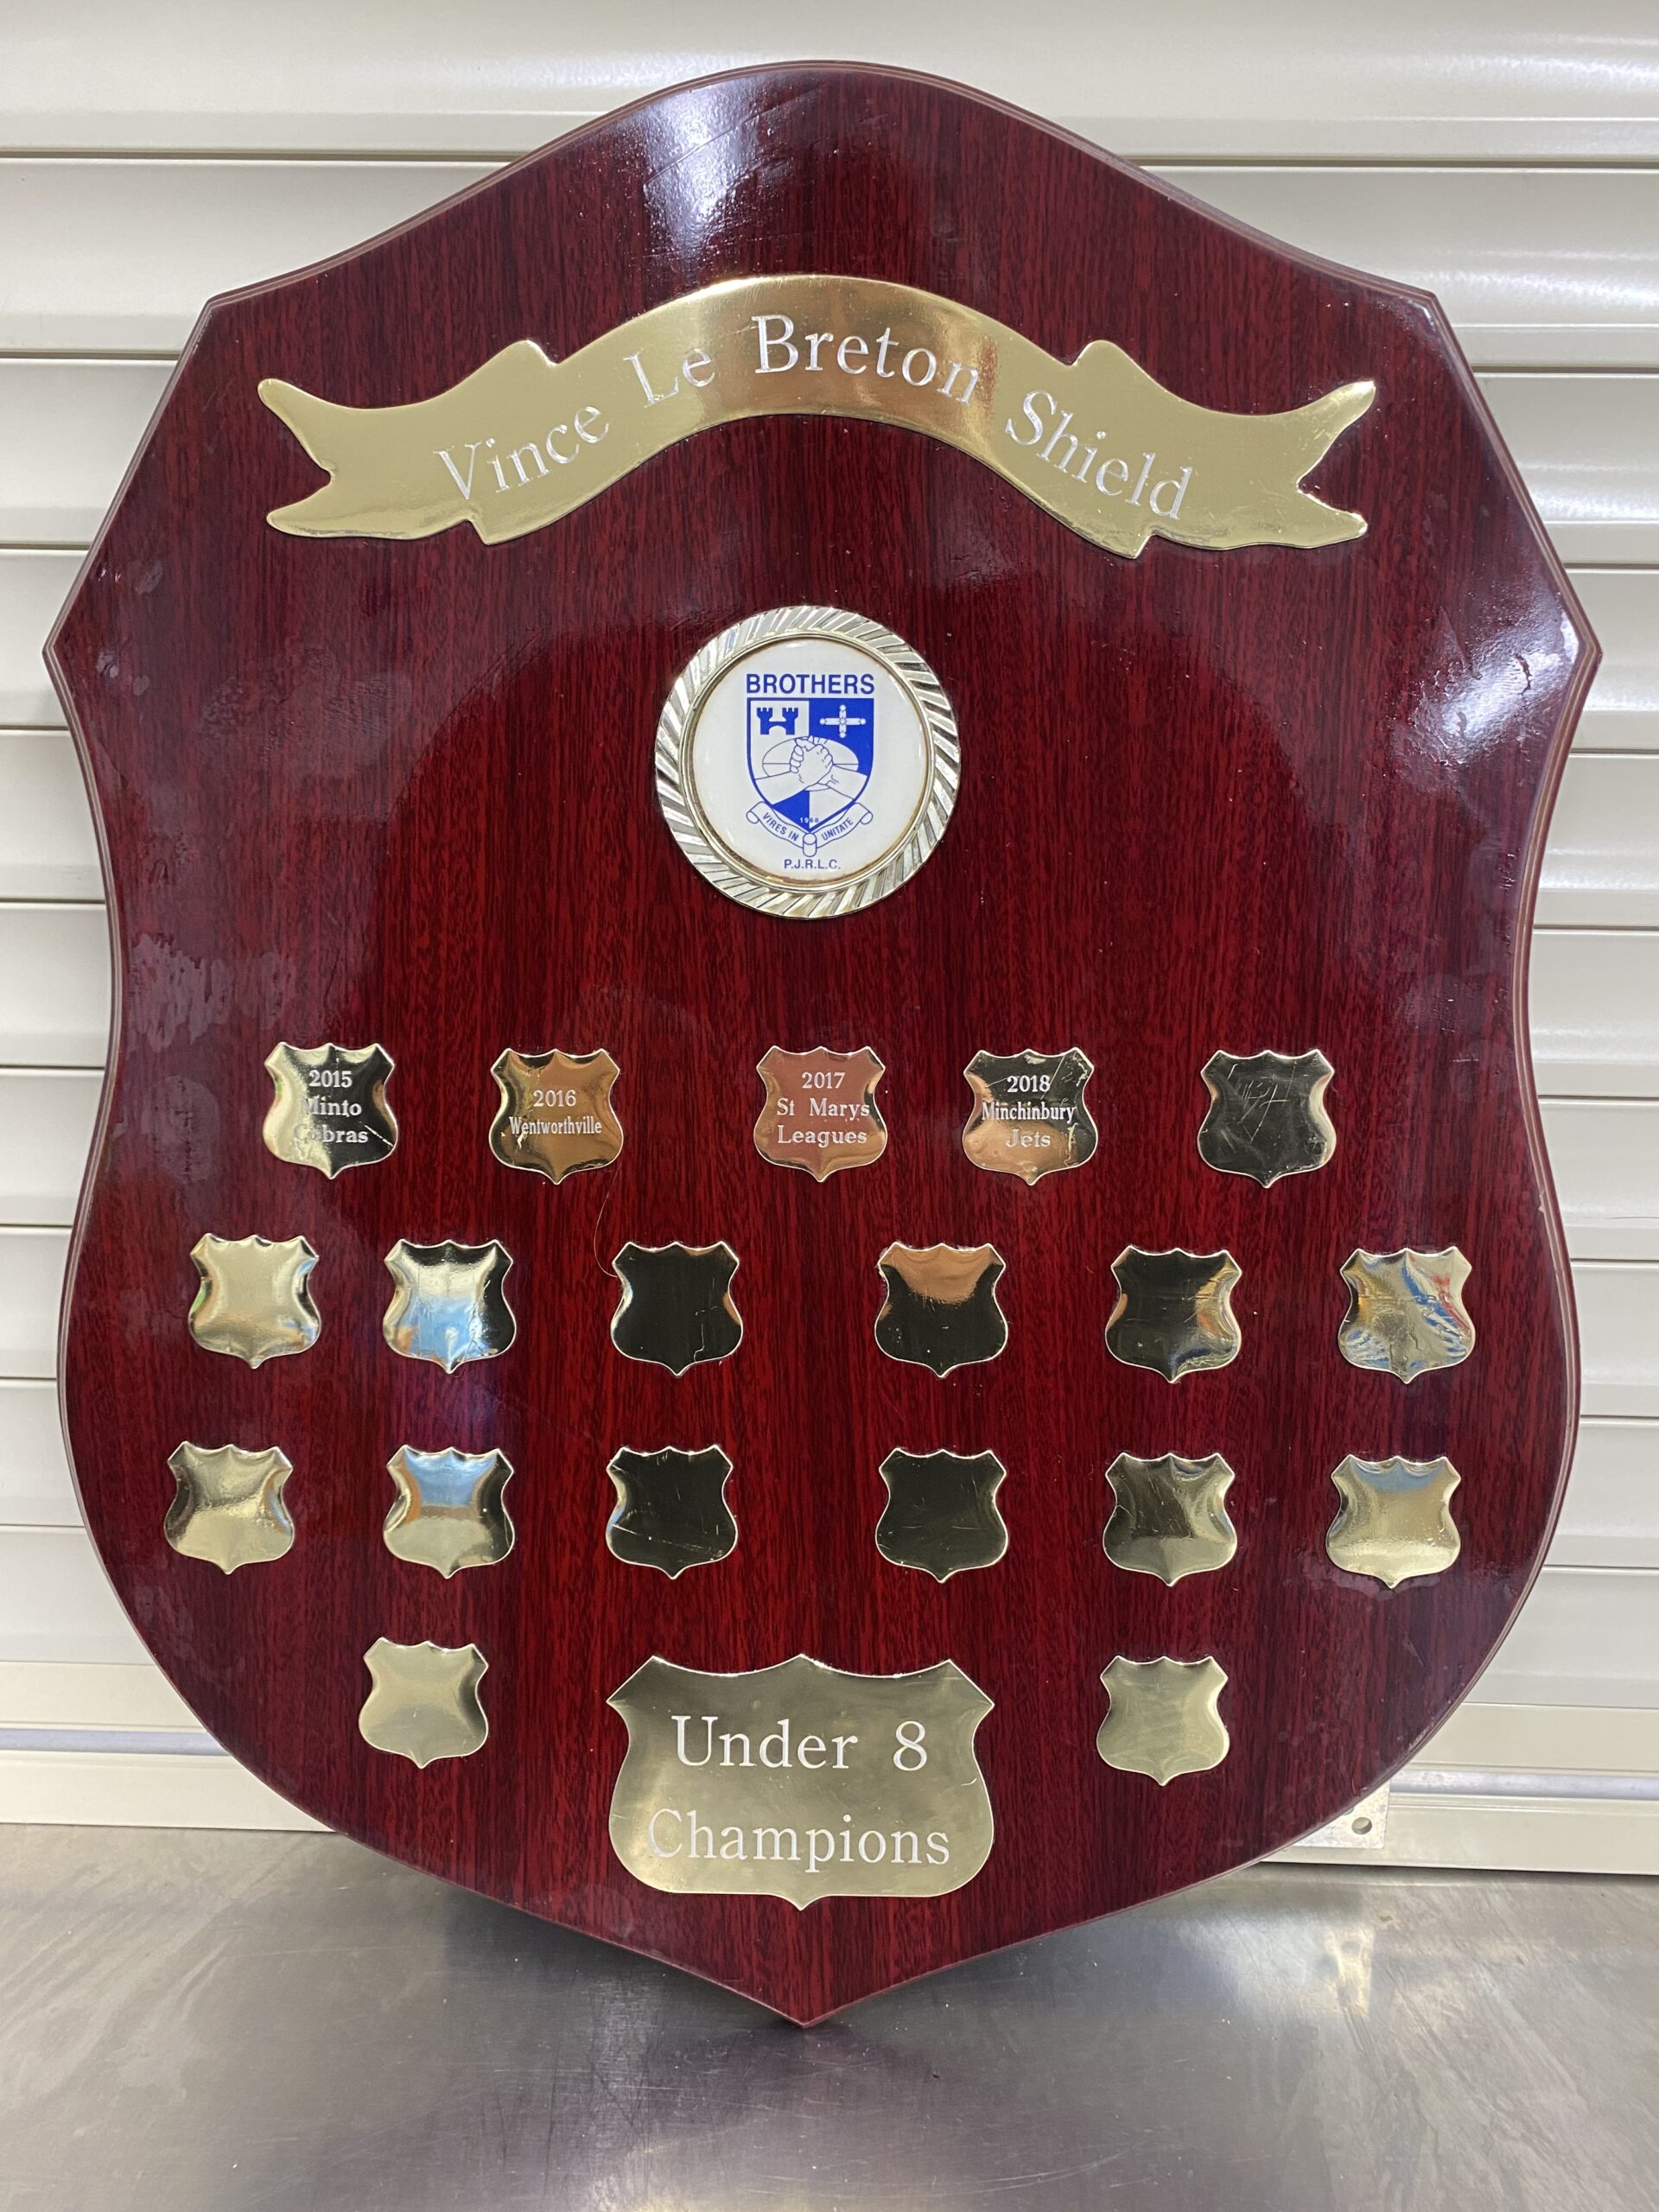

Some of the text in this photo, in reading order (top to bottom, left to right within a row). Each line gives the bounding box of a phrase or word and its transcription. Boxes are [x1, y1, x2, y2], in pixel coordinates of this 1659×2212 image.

[431, 314, 1193, 520] Vince Le Breton Shield
[746, 673, 875, 695] BROTHERS
[762, 811, 854, 842] VIRES IN UNITATE
[308, 1070, 353, 1088] 2015
[801, 1071, 846, 1089] 2017
[1007, 1075, 1051, 1093] 2018
[303, 1096, 362, 1116] Minto
[533, 1090, 577, 1108] 2016
[777, 1097, 870, 1122] St Marys
[982, 1101, 1077, 1124] Minchinbury
[508, 1116, 602, 1135] Wentworthville
[777, 1125, 868, 1148] Leagues
[1005, 1128, 1051, 1147] Jets
[671, 1715, 928, 1771] Under 8
[648, 1808, 950, 1873] Champions
